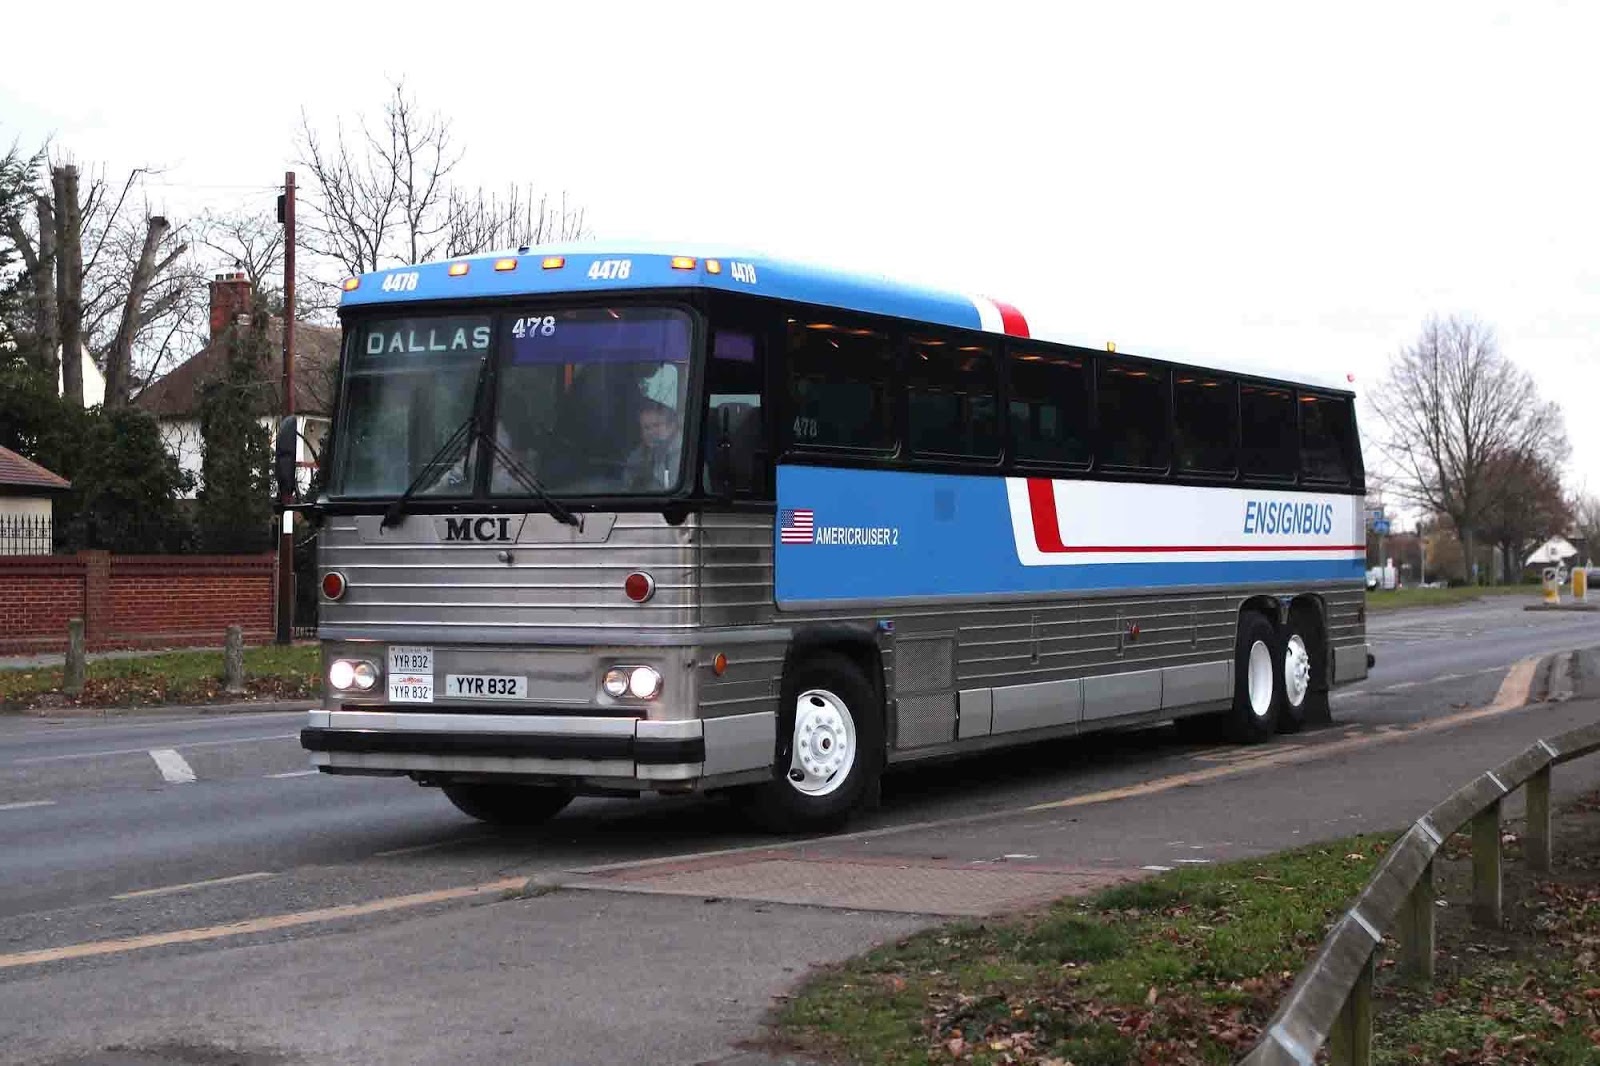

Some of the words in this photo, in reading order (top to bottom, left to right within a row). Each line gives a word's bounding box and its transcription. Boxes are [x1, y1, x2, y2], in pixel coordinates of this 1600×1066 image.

[588, 259, 632, 280] 4478
[731, 261, 757, 284] 4478
[382, 271, 419, 292] 4478
[512, 316, 556, 338] 478
[367, 326, 491, 355] DALLAS
[793, 415, 818, 437] 478
[1244, 501, 1333, 535] ENSIGNBUS
[445, 517, 511, 541] MCI
[815, 527, 891, 545] AMERICRUISER
[892, 529, 898, 545] 2
[394, 654, 410, 668] YYR
[412, 655, 428, 669] 832
[394, 685, 410, 698] YYR
[412, 686, 428, 699] 832
[456, 677, 485, 694] YYR
[487, 677, 517, 695] 832
